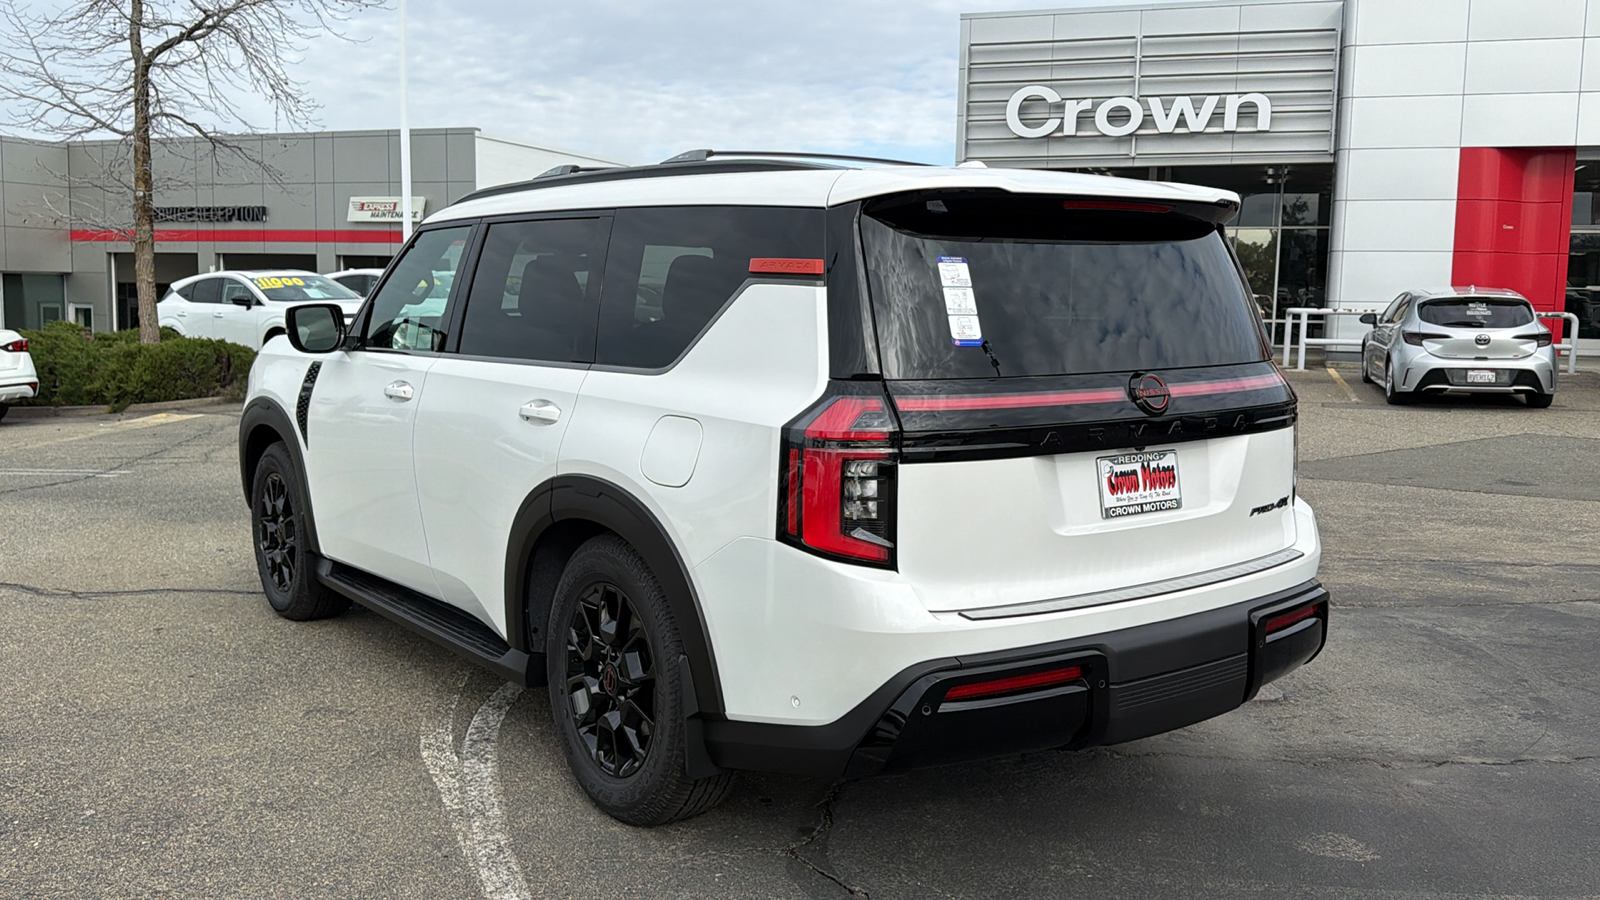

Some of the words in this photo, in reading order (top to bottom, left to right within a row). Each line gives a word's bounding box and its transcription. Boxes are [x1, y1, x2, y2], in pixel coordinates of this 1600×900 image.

[1006, 85, 1272, 138] Crown
[1139, 387, 1170, 397] NISSAN
[1040, 414, 1250, 446] ARMADA
[1118, 452, 1160, 464] REDDING
[1107, 466, 1140, 496] Crown
[1141, 461, 1176, 492] Motors
[1110, 505, 1141, 517] CROWN
[1143, 500, 1178, 512] MOTORS
